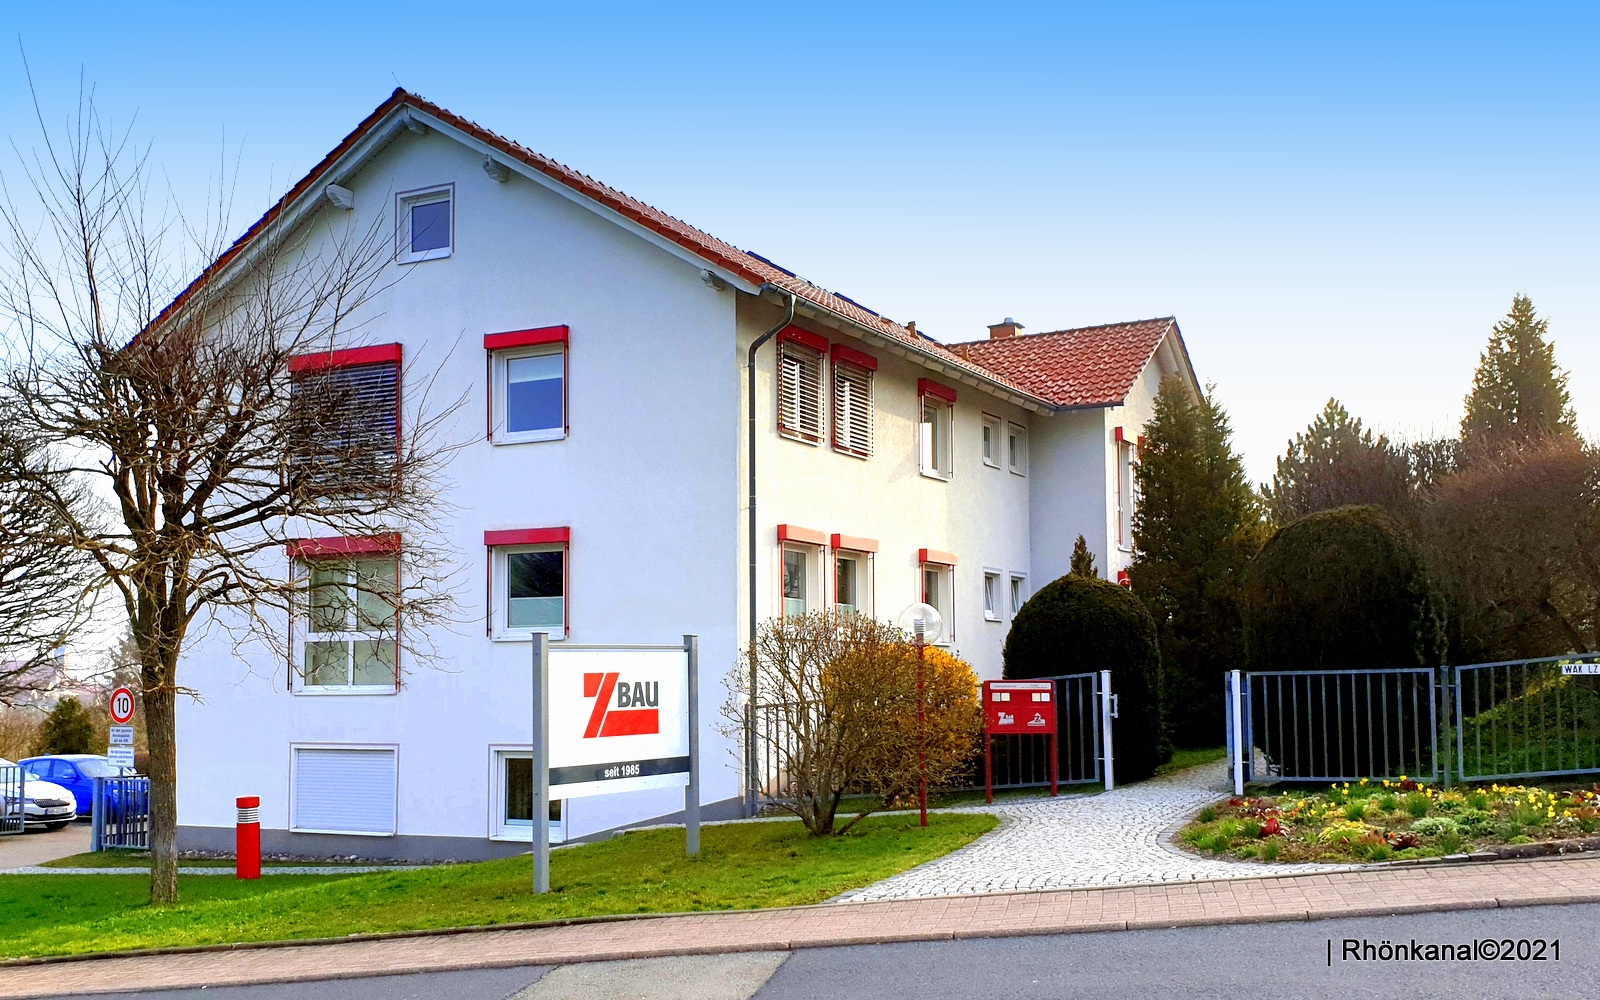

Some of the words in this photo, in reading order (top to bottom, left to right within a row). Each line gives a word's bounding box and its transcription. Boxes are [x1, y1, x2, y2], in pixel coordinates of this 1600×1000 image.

[1564, 665, 1583, 674] WAK
[617, 681, 659, 708] BAU
[117, 697, 129, 713] 10
[604, 766, 620, 778] seit
[621, 764, 640, 776] 1985
